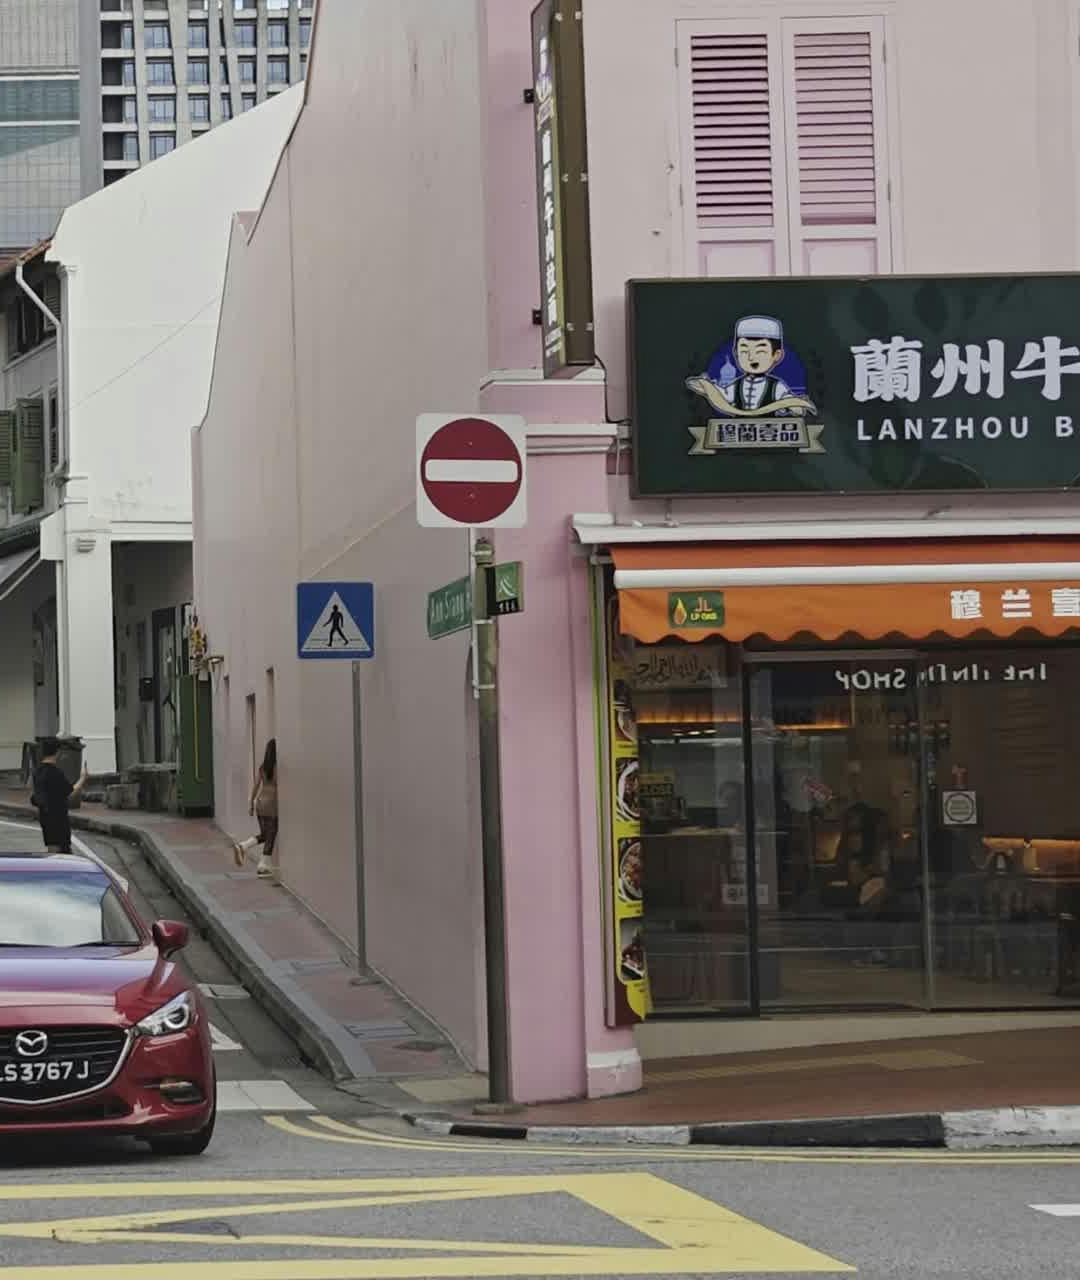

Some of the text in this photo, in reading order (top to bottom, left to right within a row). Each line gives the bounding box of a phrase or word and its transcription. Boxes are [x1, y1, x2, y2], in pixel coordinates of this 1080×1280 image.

[850, 335, 1080, 403] 蘭州牛
[857, 416, 1029, 441] LANZHOU
